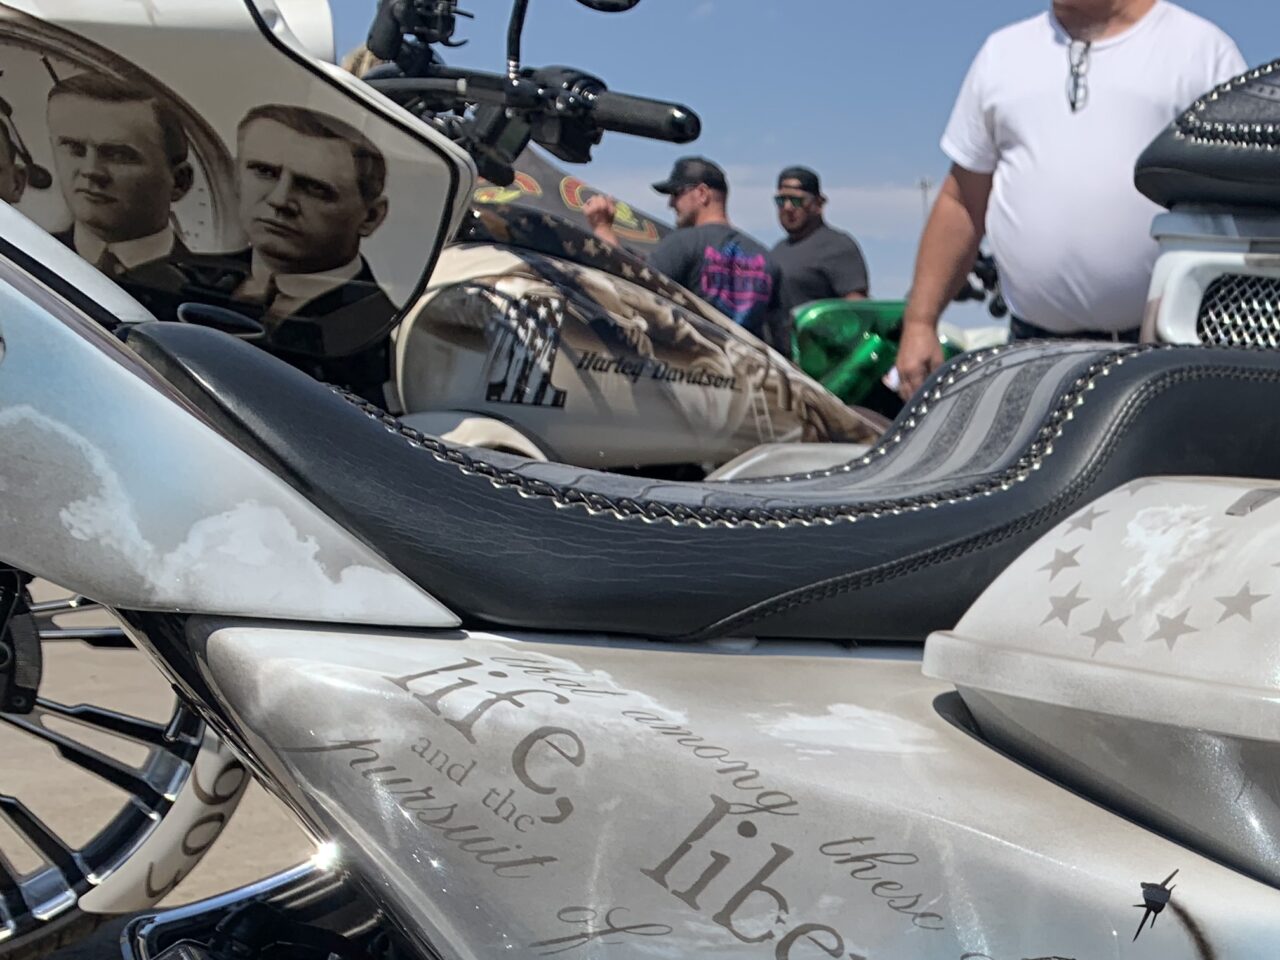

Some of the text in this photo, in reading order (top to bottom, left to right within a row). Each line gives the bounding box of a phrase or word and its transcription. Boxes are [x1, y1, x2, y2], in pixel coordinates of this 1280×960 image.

[577, 352, 644, 384] Harley
[411, 737, 535, 832] and the
[622, 710, 798, 816] among
[818, 835, 945, 931] these
